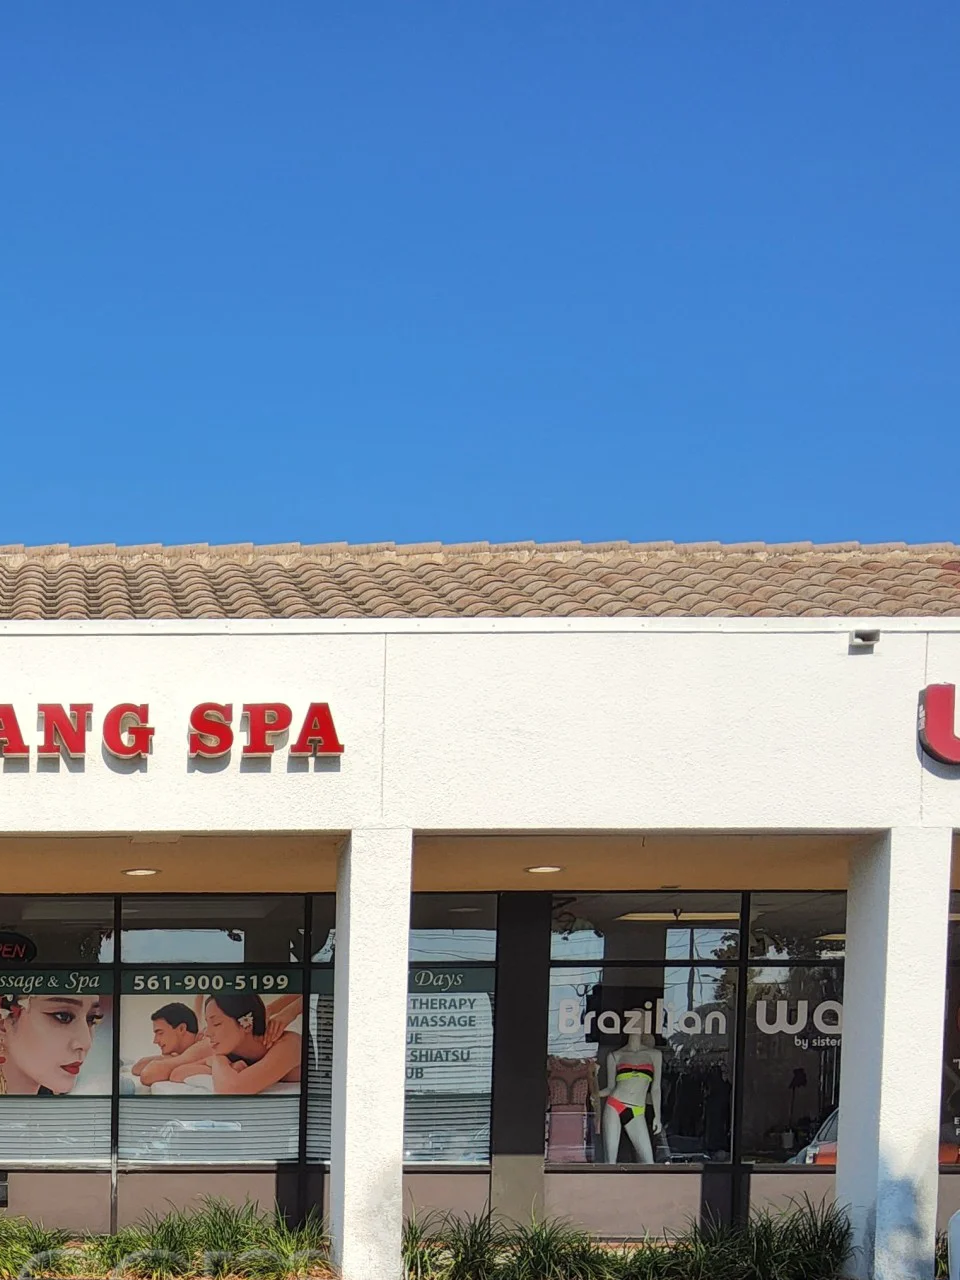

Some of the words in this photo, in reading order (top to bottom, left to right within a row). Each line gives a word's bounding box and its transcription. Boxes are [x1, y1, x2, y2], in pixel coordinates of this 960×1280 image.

[189, 702, 345, 758] SPA
[47, 975, 60, 988] &
[65, 971, 100, 993] Spa
[133, 974, 289, 991] 561-900-5199
[414, 970, 464, 992] Days
[410, 998, 477, 1010] THERAPY
[407, 1015, 477, 1028] MASSAGE
[558, 998, 727, 1034] Brazilian
[794, 1034, 809, 1050] by
[410, 1049, 471, 1062] SHIATSU
